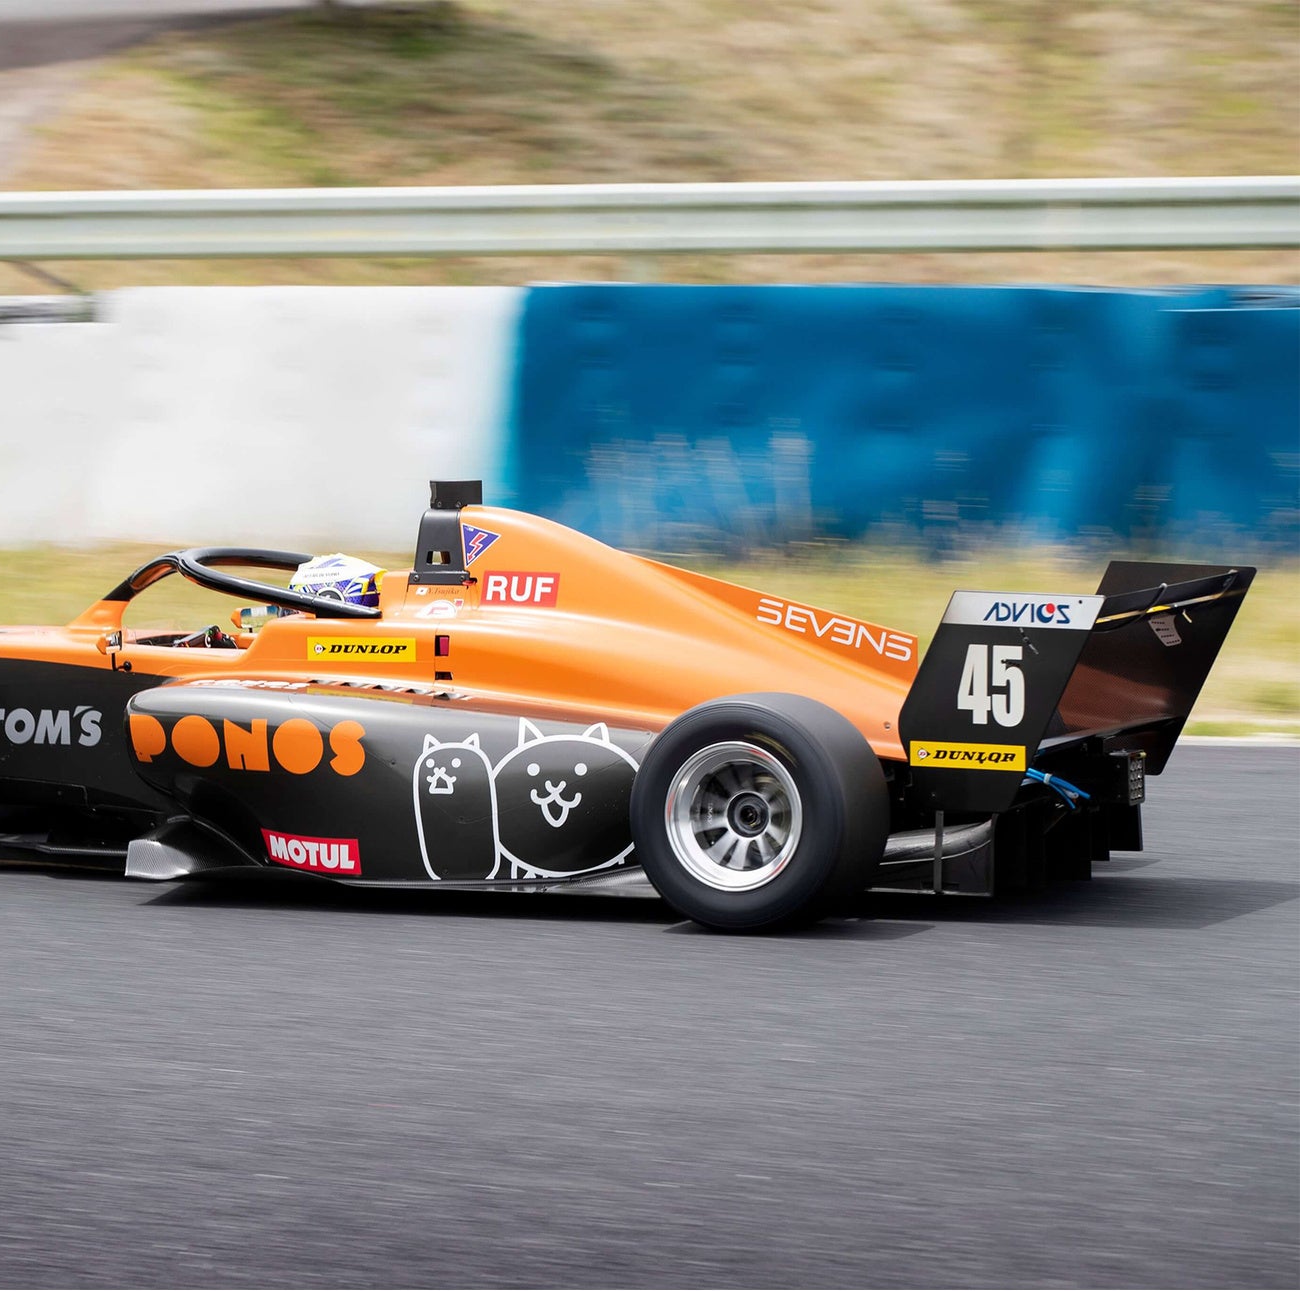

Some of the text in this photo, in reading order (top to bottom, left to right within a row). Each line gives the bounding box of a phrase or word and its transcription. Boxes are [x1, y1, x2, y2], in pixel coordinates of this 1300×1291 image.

[485, 575, 555, 602] RUF
[328, 644, 408, 655] DUNLOP
[957, 643, 1026, 728] 45
[129, 713, 366, 776] PONOS
[933, 749, 1016, 764] DUNLOP
[269, 834, 355, 870] MOTUL
